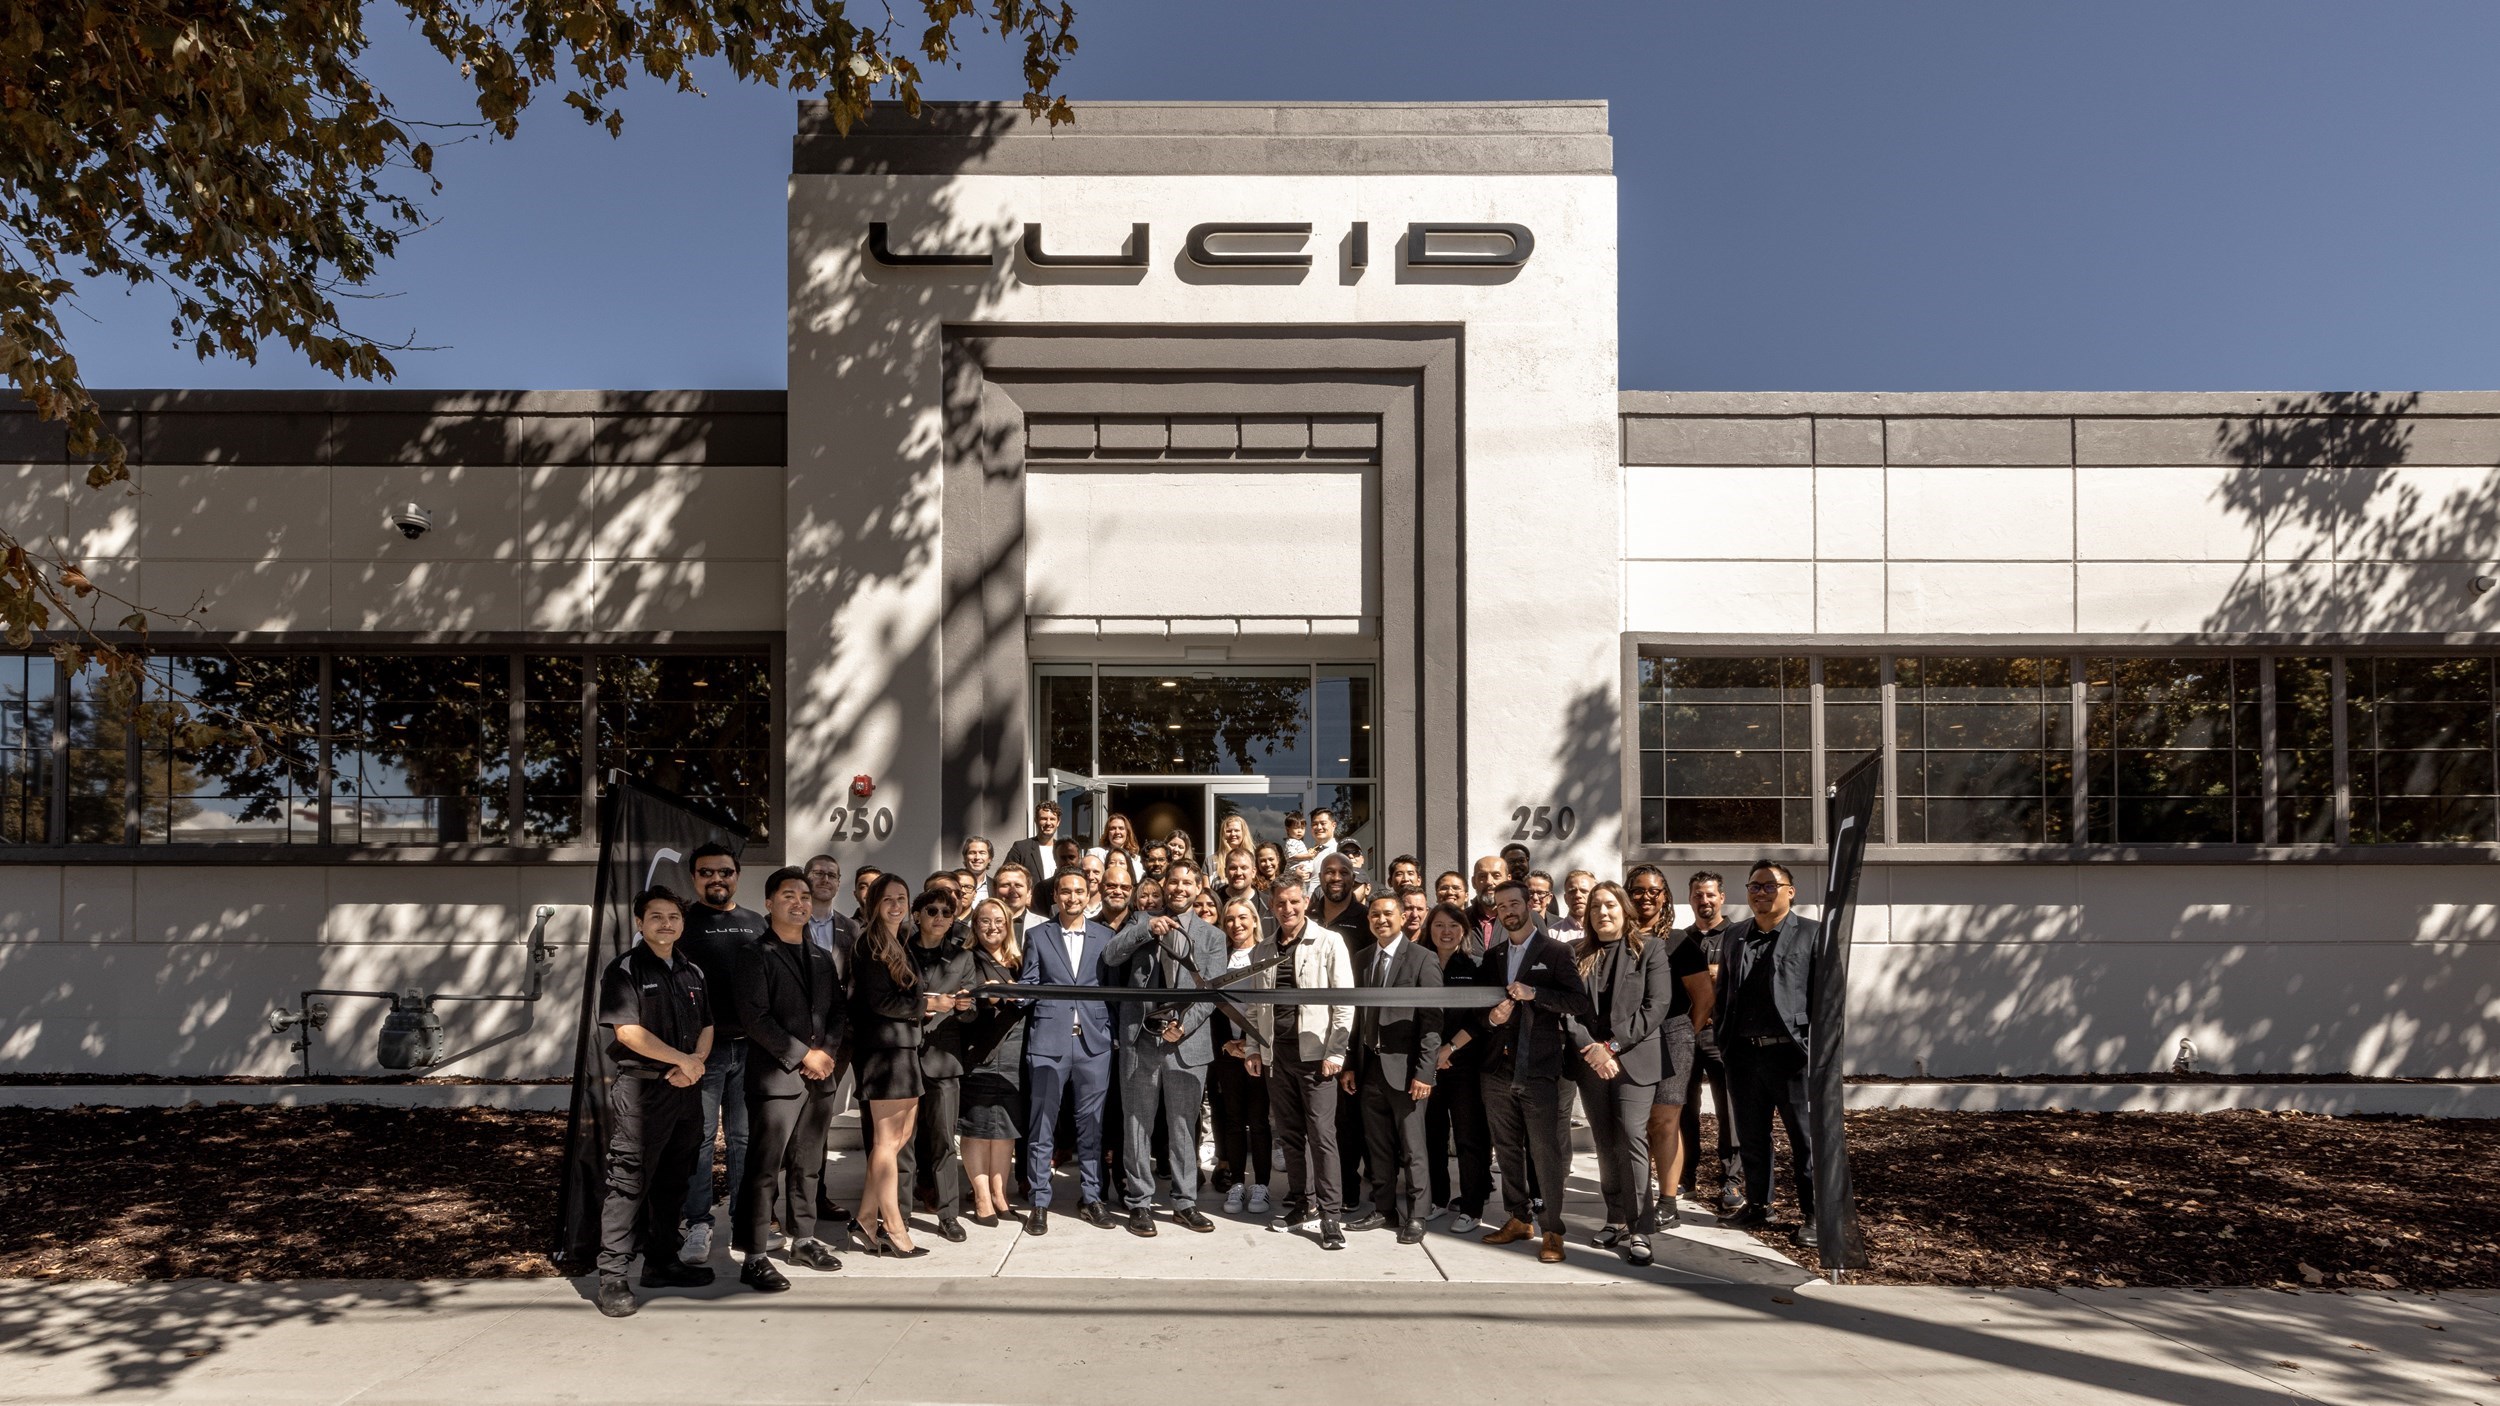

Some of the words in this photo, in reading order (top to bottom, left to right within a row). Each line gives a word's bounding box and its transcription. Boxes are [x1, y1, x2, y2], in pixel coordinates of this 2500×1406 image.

[868, 221, 1535, 268] LUCID
[829, 806, 894, 842] 250
[1511, 805, 1575, 841] 250
